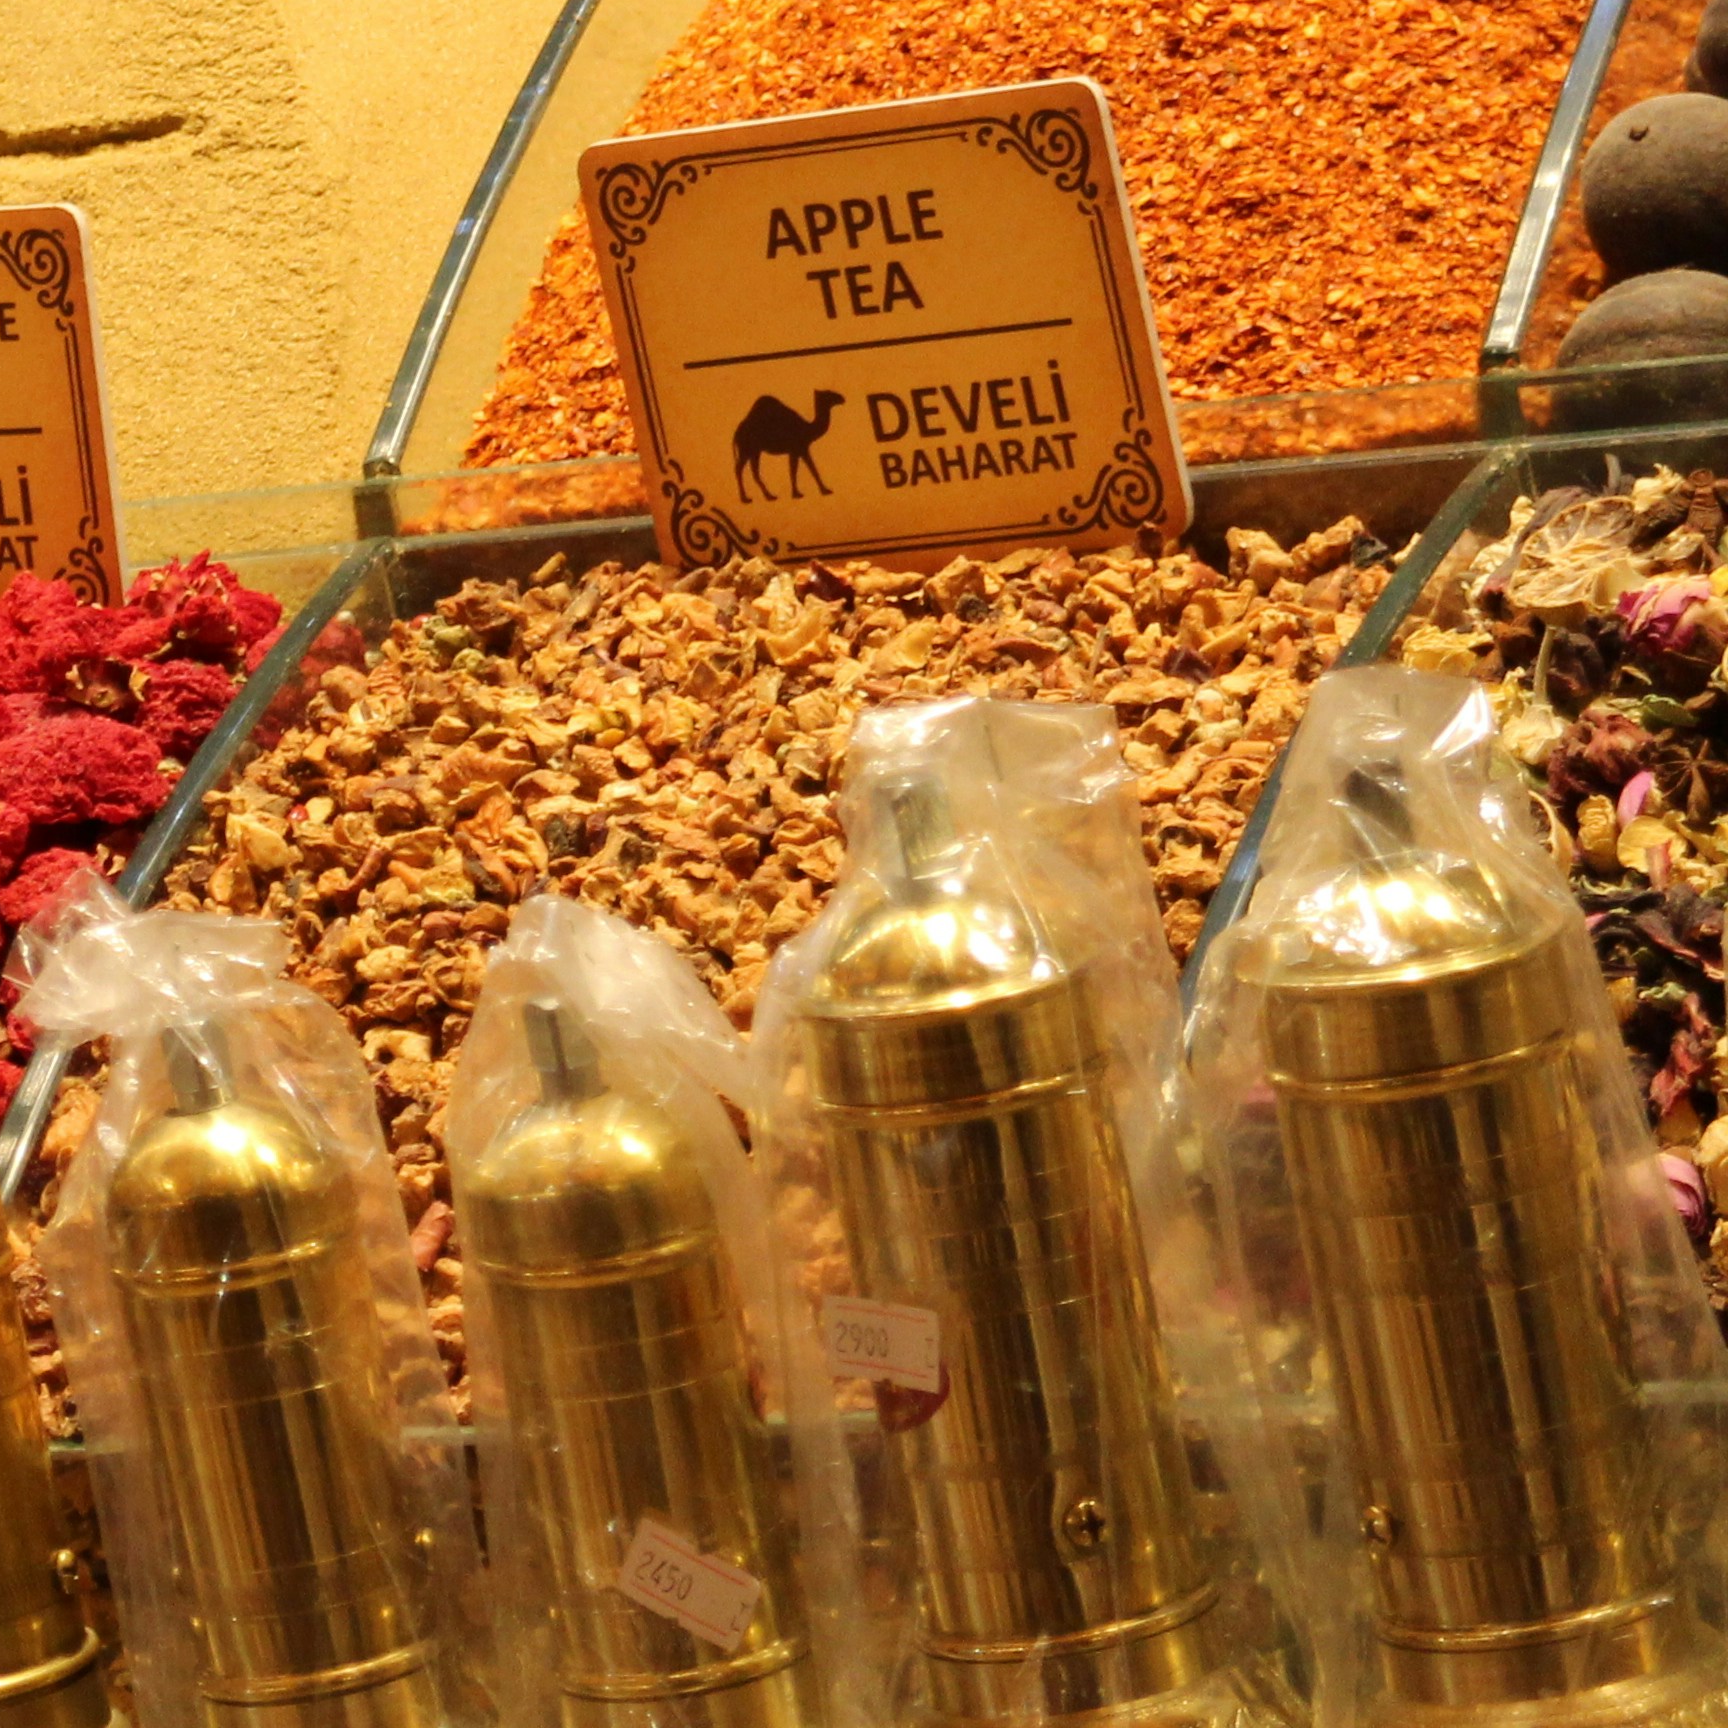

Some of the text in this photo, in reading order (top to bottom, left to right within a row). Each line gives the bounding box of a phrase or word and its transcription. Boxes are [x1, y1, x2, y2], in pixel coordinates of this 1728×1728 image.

[765, 188, 943, 260] APPLE
[806, 260, 924, 320] TEA
[879, 432, 1078, 490] BAHARAT
[634, 1551, 693, 1601] 2450
